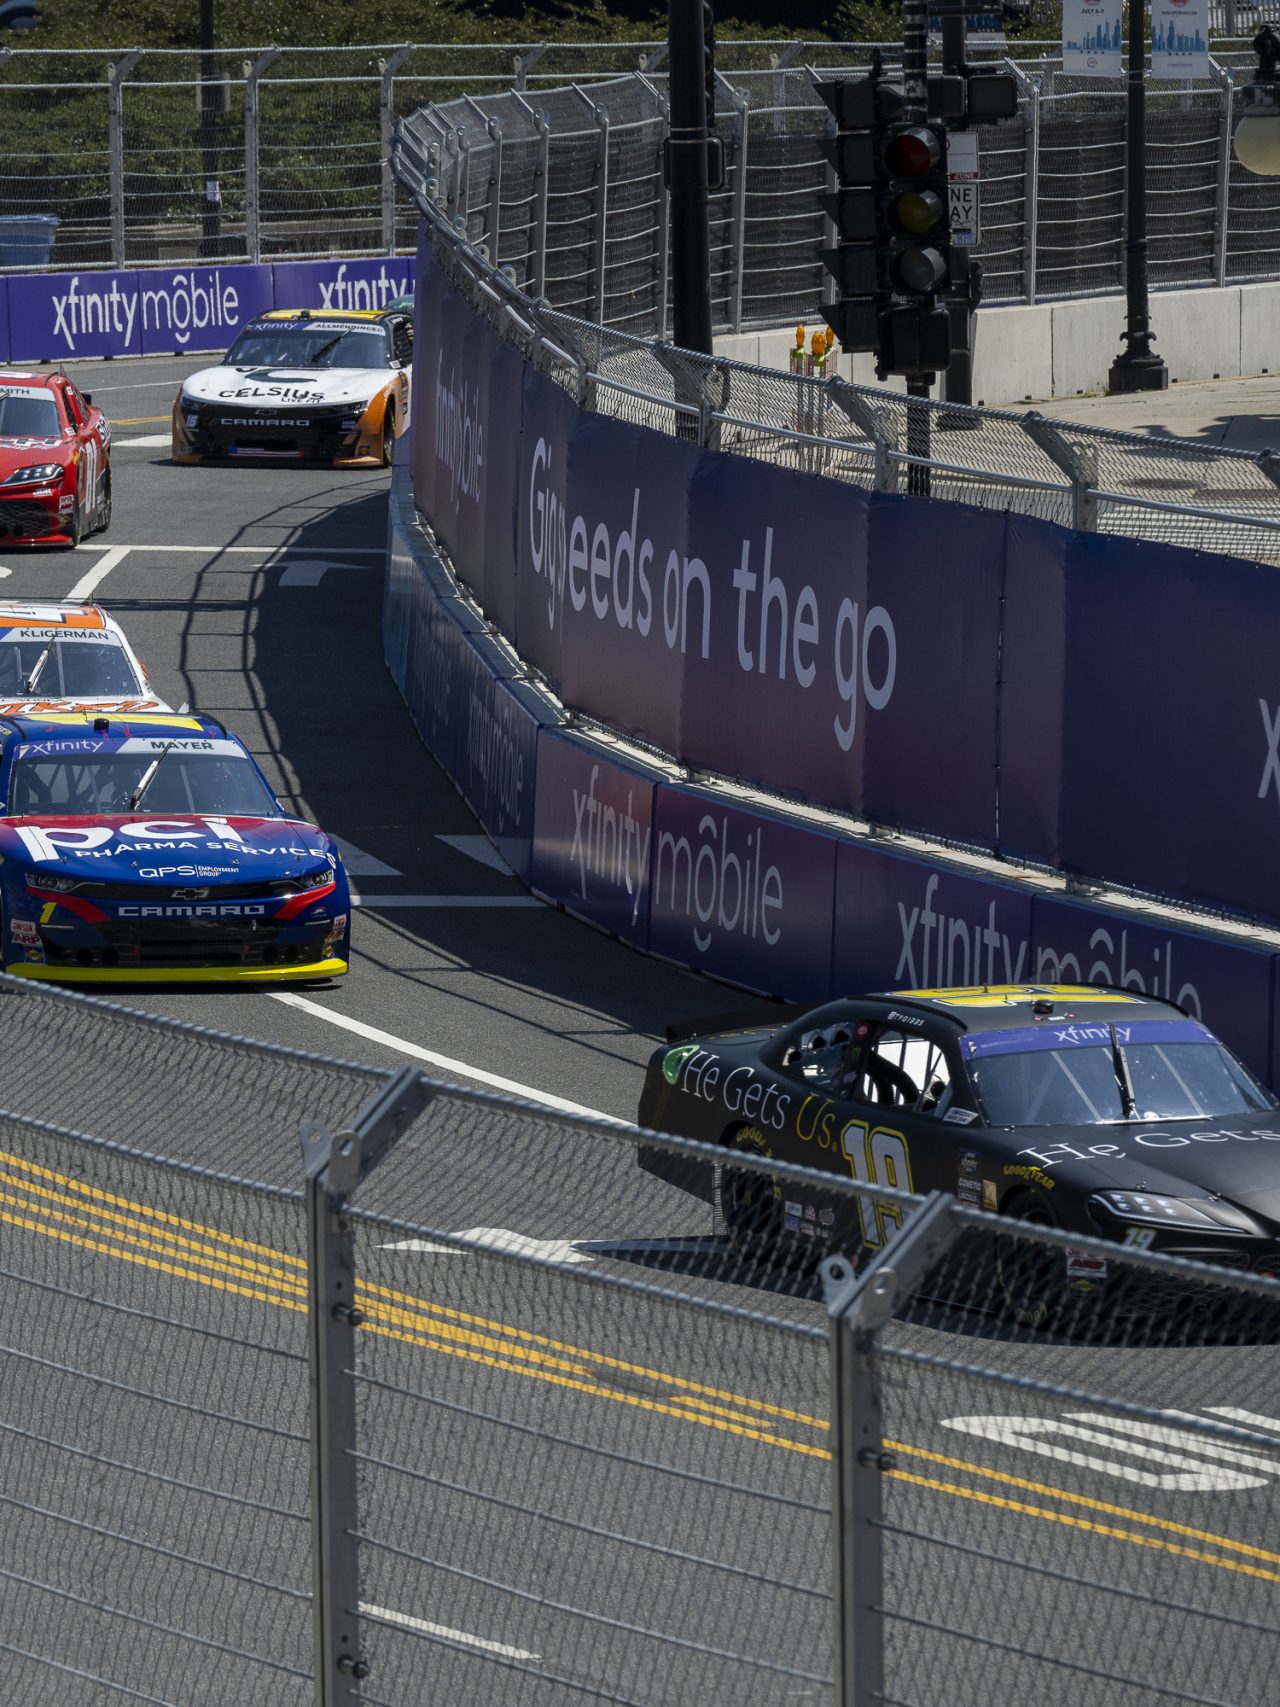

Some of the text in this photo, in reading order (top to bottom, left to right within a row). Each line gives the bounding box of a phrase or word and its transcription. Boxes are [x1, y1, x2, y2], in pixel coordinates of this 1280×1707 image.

[950, 187, 972, 203] NE
[950, 205, 973, 220] AY
[319, 264, 408, 310] xfinity
[51, 276, 138, 351] xfinity
[254, 322, 299, 332] xfinity
[218, 386, 326, 400] CELSIUS
[185, 414, 199, 428] 16
[220, 417, 311, 427] CAMARO
[19, 629, 110, 641] KLIGERMAN
[663, 549, 711, 659] on
[732, 526, 820, 688] the
[833, 597, 898, 752] go
[31, 739, 214, 754] xfinity MAYER
[570, 764, 651, 927] xfinity
[74, 841, 337, 870] PHARMA SERVICES
[138, 865, 196, 878] QPS
[118, 904, 265, 917] CAMARO
[1057, 1024, 1132, 1044] xfinity
[681, 1050, 720, 1102] He
[722, 1065, 791, 1130] Gets
[1016, 1129, 1280, 1169] He Gets
[1003, 1165, 1056, 1190] GOODYEAR
